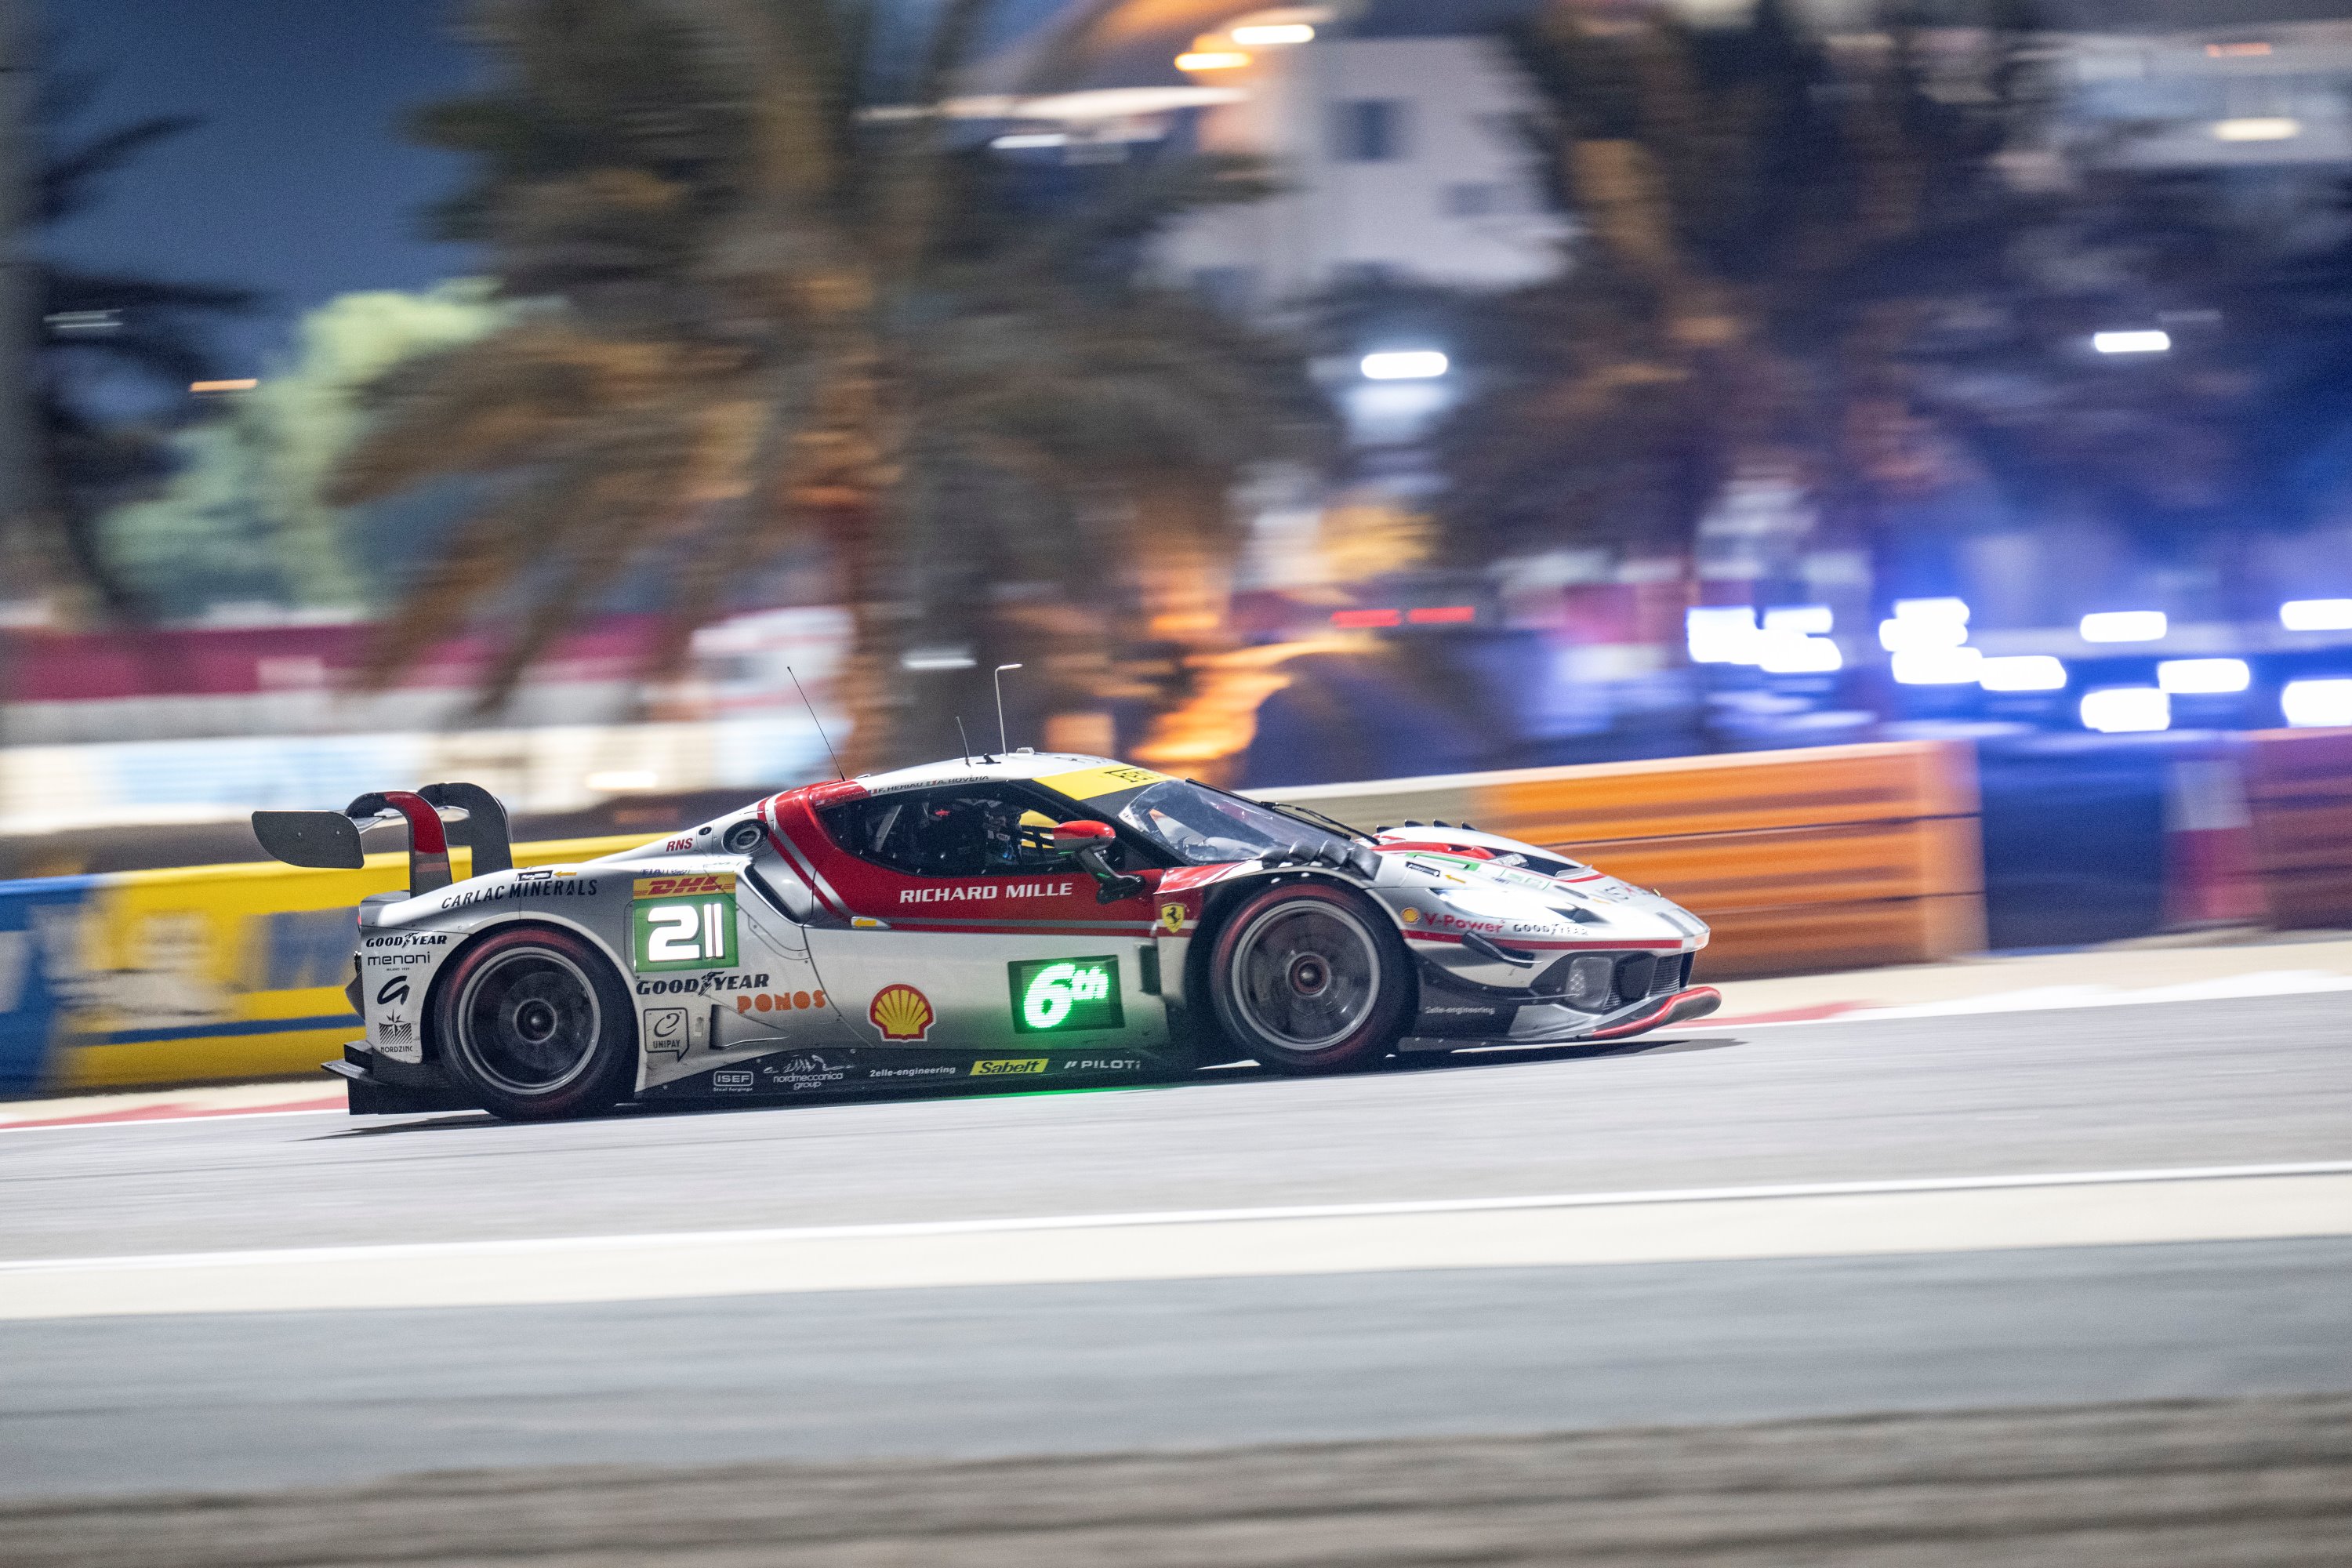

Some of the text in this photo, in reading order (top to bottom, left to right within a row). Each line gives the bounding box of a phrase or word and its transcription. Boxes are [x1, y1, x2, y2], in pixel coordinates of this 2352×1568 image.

[666, 837, 693, 852] RNS
[441, 878, 598, 909] CARLAC MINERALS
[648, 876, 722, 895] DHL
[899, 882, 1073, 903] RICHARD MILLE
[1423, 911, 1504, 933] V-Power
[648, 902, 724, 961] 21
[368, 951, 430, 966] menoni
[737, 989, 826, 1014] PONOS
[1023, 962, 1109, 1029] 6th
[653, 1040, 681, 1049] UNIPAY
[869, 1065, 956, 1077] 2elle-engineering
[979, 1060, 1041, 1074] Sabelt
[773, 1072, 844, 1083] nordmeccanica
[793, 1081, 822, 1091] group
